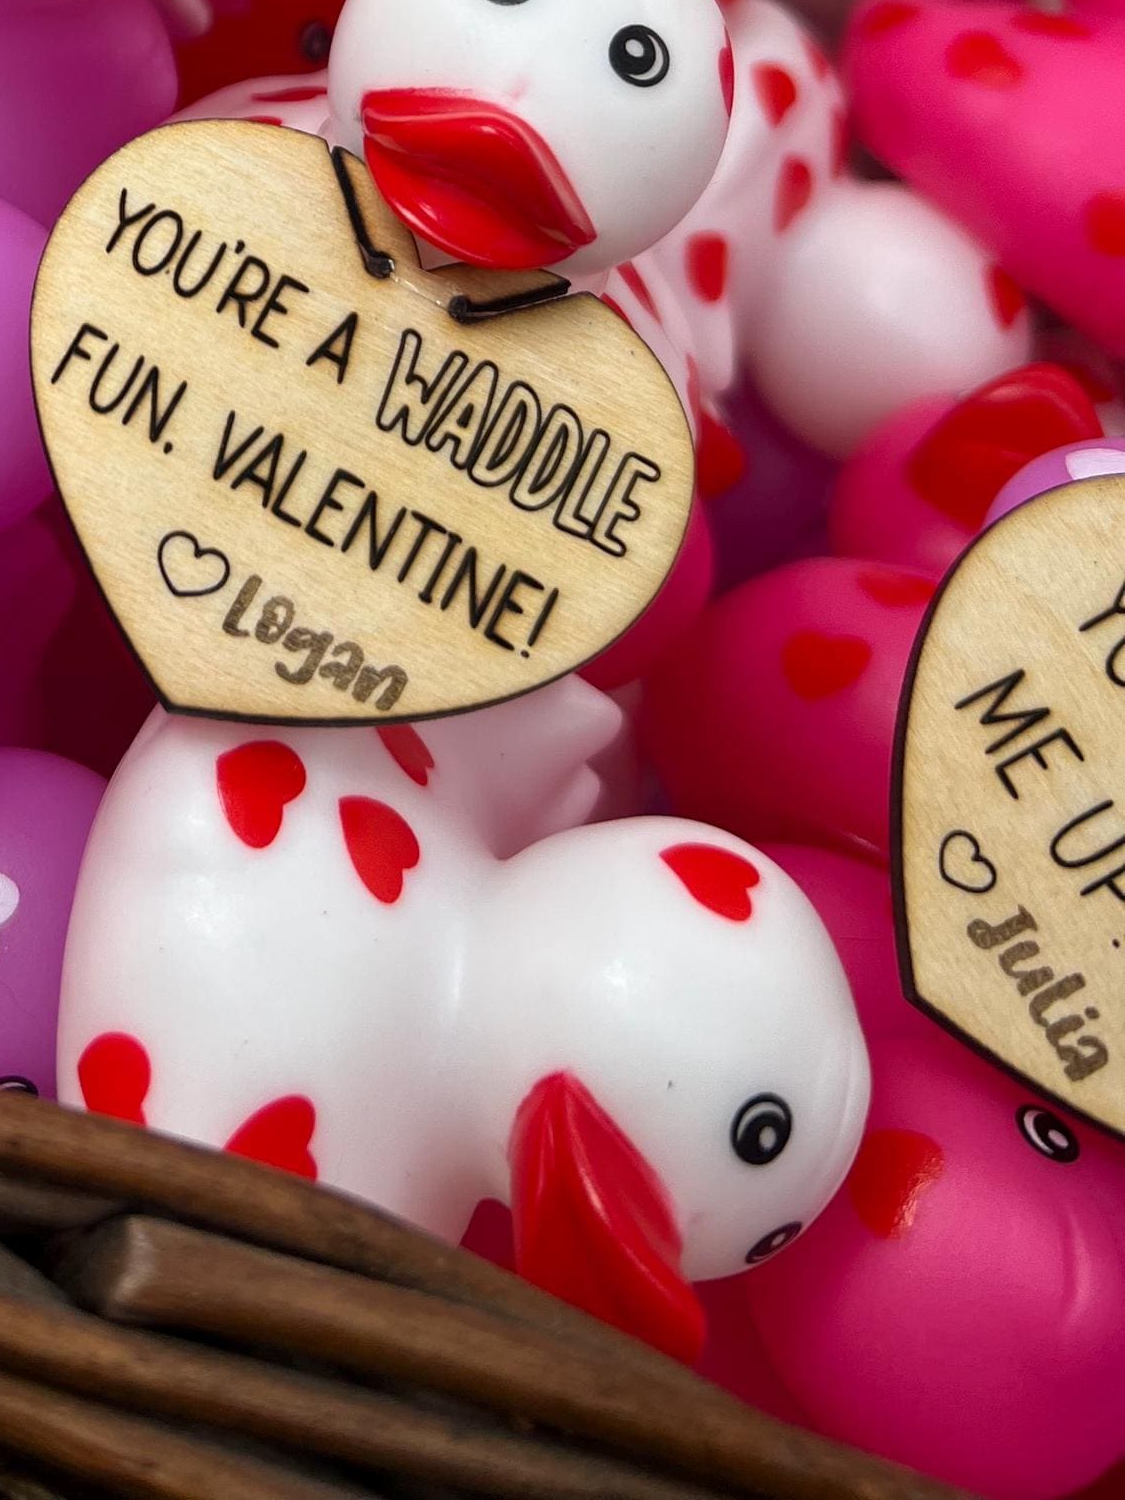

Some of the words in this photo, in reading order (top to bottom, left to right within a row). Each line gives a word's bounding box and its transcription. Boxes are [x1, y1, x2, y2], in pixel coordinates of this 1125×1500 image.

[105, 187, 309, 348] YOU'RE
[306, 312, 359, 383] A
[374, 328, 661, 558] WADDLE
[213, 410, 560, 658] VALENTINE!
[222, 574, 409, 711] Logan
[954, 669, 1084, 800] ME
[966, 904, 1109, 1084] Julia
